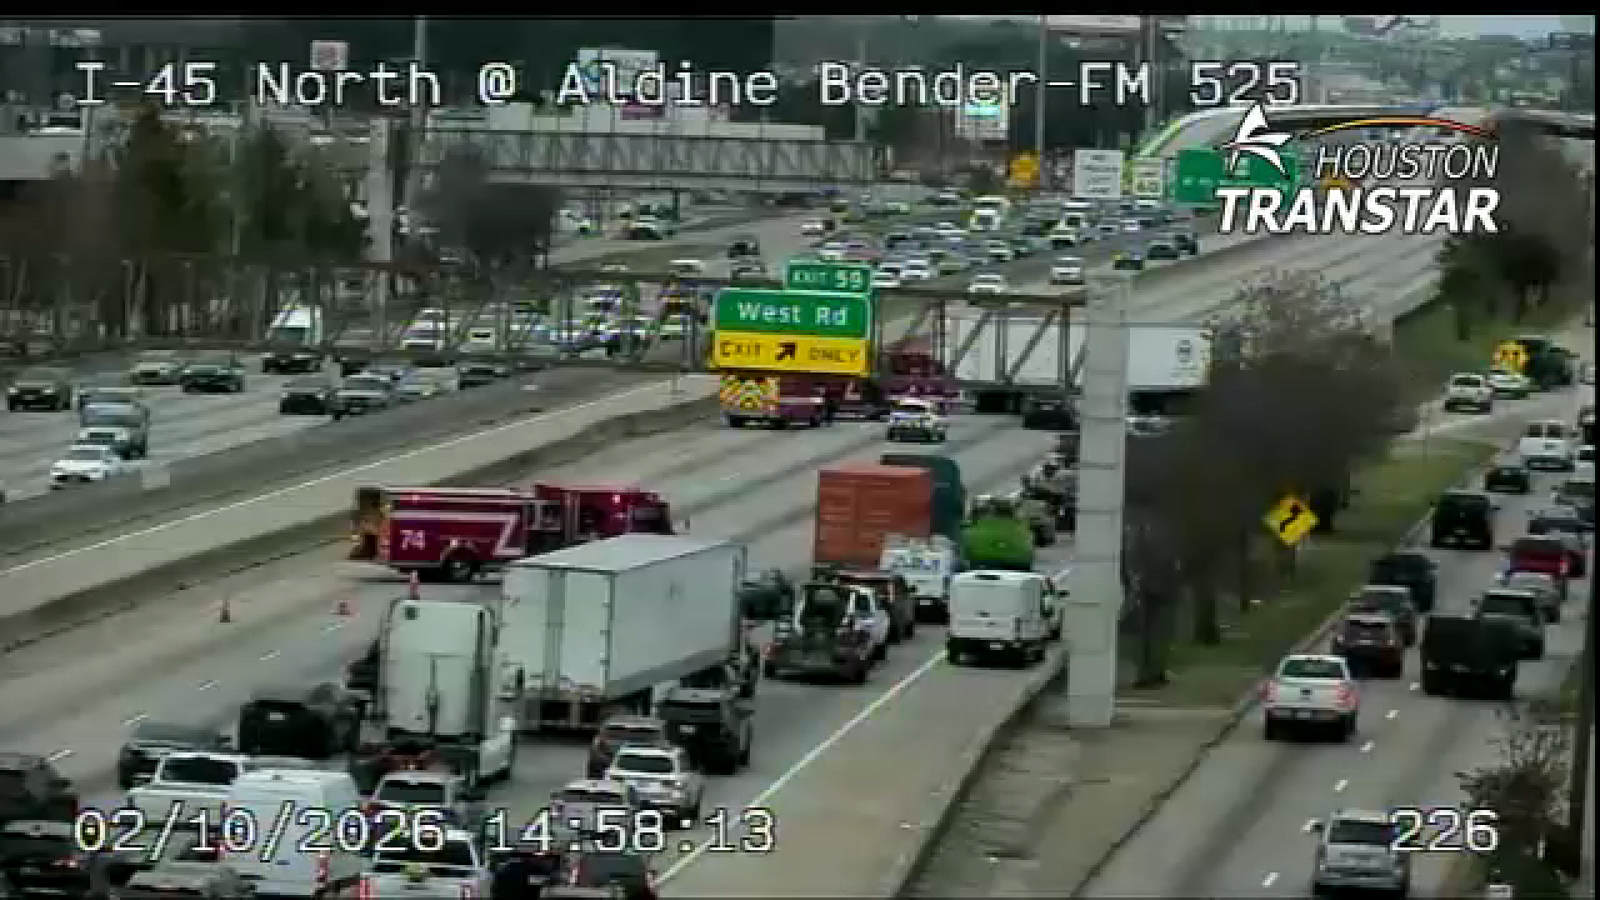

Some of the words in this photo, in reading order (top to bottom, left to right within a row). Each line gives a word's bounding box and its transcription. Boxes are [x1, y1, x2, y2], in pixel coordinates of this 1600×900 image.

[833, 268, 863, 289] 59
[737, 301, 802, 324] West
[814, 305, 848, 326] Rd
[719, 341, 761, 358] EXIT
[808, 346, 860, 364] ONLY
[400, 529, 426, 551] 74
